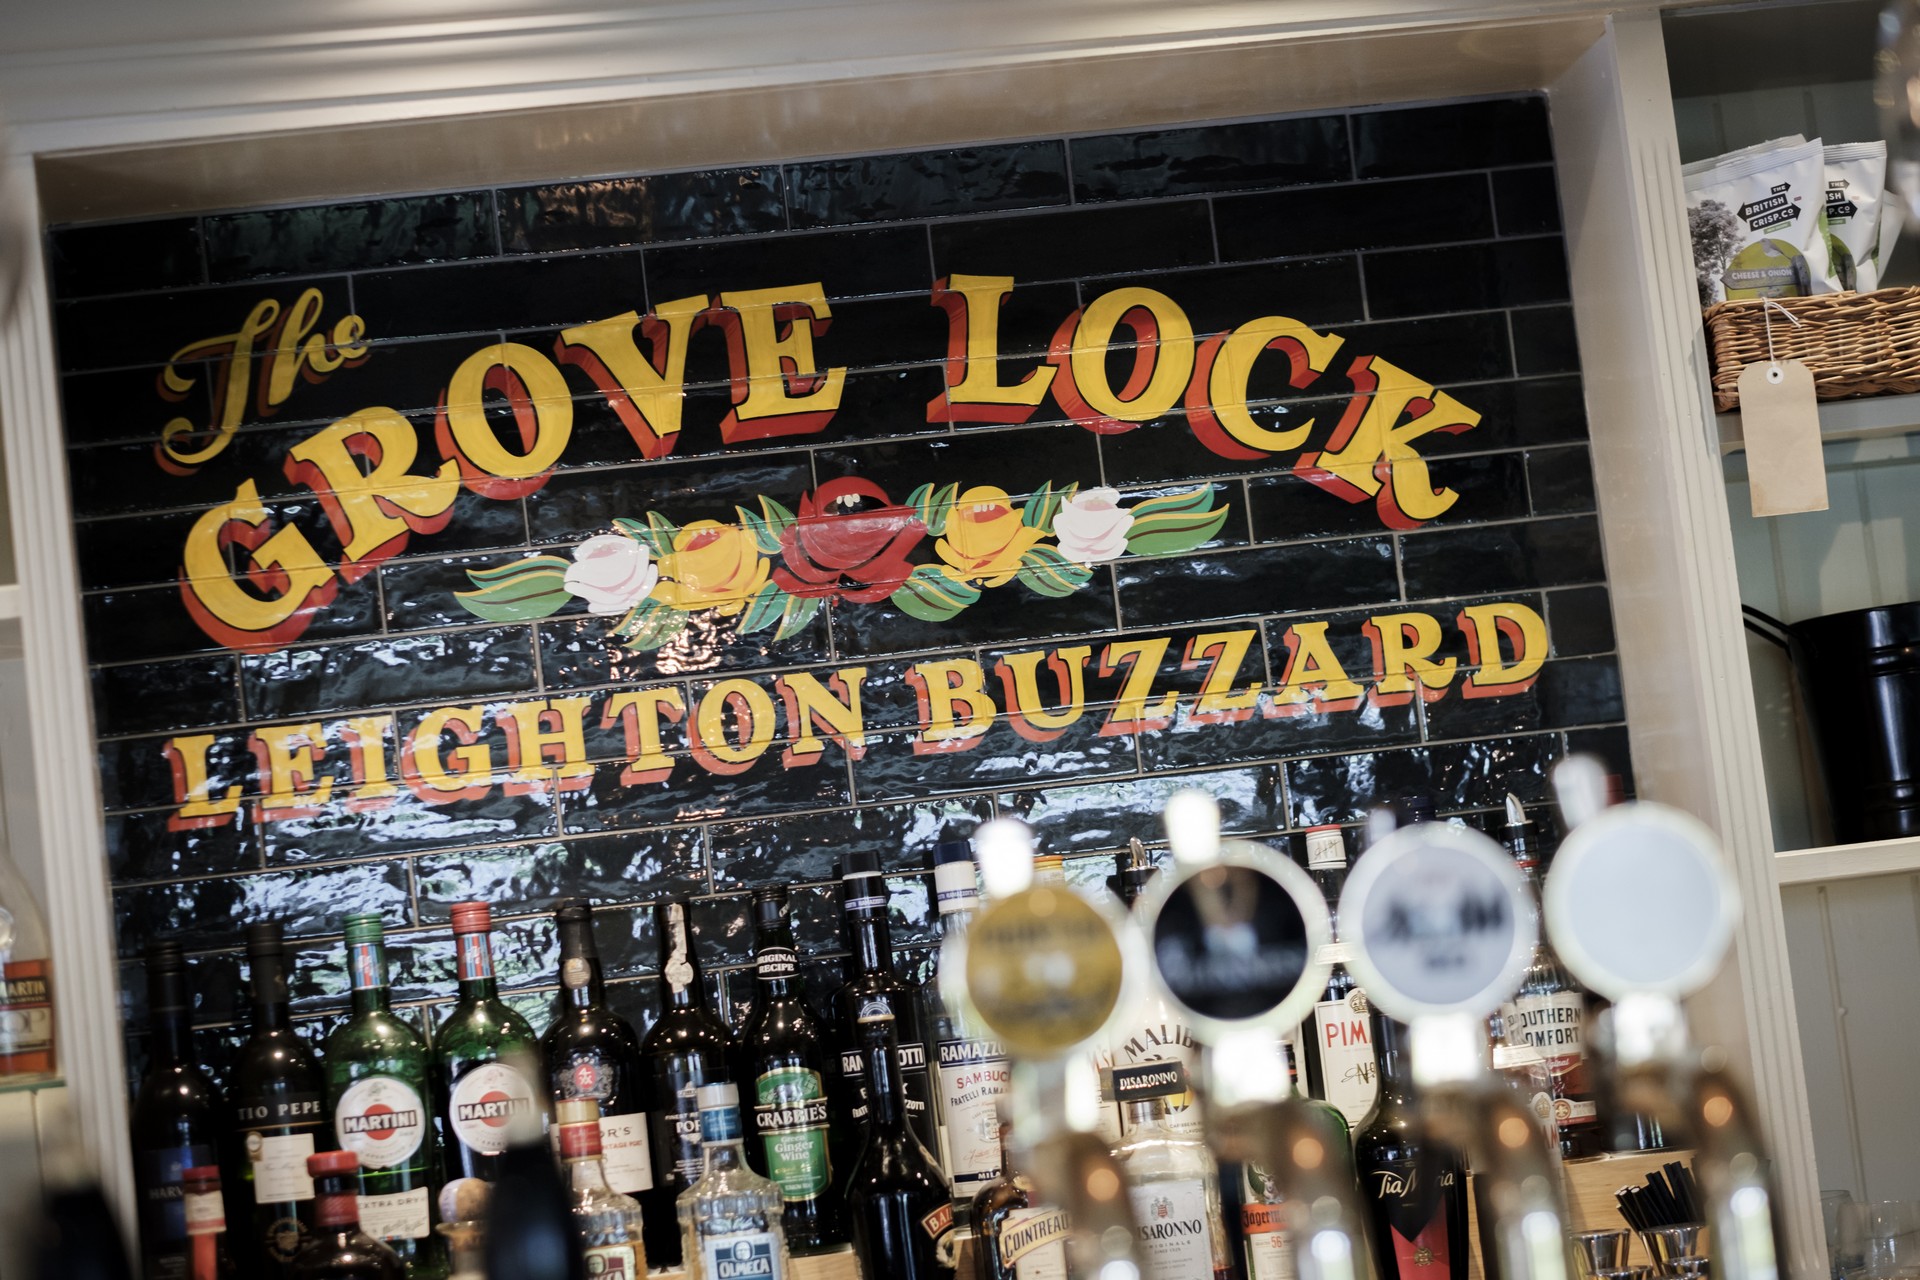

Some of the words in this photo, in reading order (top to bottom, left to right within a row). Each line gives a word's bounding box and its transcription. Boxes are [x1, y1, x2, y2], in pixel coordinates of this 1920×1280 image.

[1772, 184, 1786, 193] THE
[1745, 196, 1785, 216] BRITISH
[1731, 270, 1760, 280] CHEESE
[1767, 268, 1793, 278] ONION
[155, 287, 370, 476] The
[178, 281, 847, 655] GROVE
[927, 272, 1482, 530] LOCK
[163, 668, 868, 832] LEIGHTON
[906, 602, 1550, 756] BUZZARD
[757, 953, 797, 965] RIGINAL
[758, 963, 795, 974] RECIPE
[1520, 1007, 1582, 1028] OUTHERN
[1124, 1024, 1195, 1063] MALIB
[1325, 1019, 1372, 1048] PIM
[1524, 1027, 1580, 1048] OMFORT
[940, 1040, 1007, 1062] RAMAZZO
[956, 1070, 1011, 1089] SAMBUC
[1119, 1070, 1178, 1091] DISARONNO
[950, 1089, 980, 1107] FRATELLI
[238, 1105, 269, 1121] TIO
[277, 1100, 321, 1117] PEPE
[756, 1103, 828, 1129] CRABBIE'S
[343, 1110, 417, 1134] MARTINI
[675, 1120, 702, 1134] POR
[774, 1140, 814, 1154] Ginger
[977, 1170, 1001, 1180] MILA
[1370, 1170, 1406, 1199] Tia
[1004, 1212, 1069, 1260] COINTREAU
[1137, 1219, 1202, 1241] ISARONNO
[1270, 1235, 1283, 1249] 56
[719, 1257, 771, 1279] OLMECA
